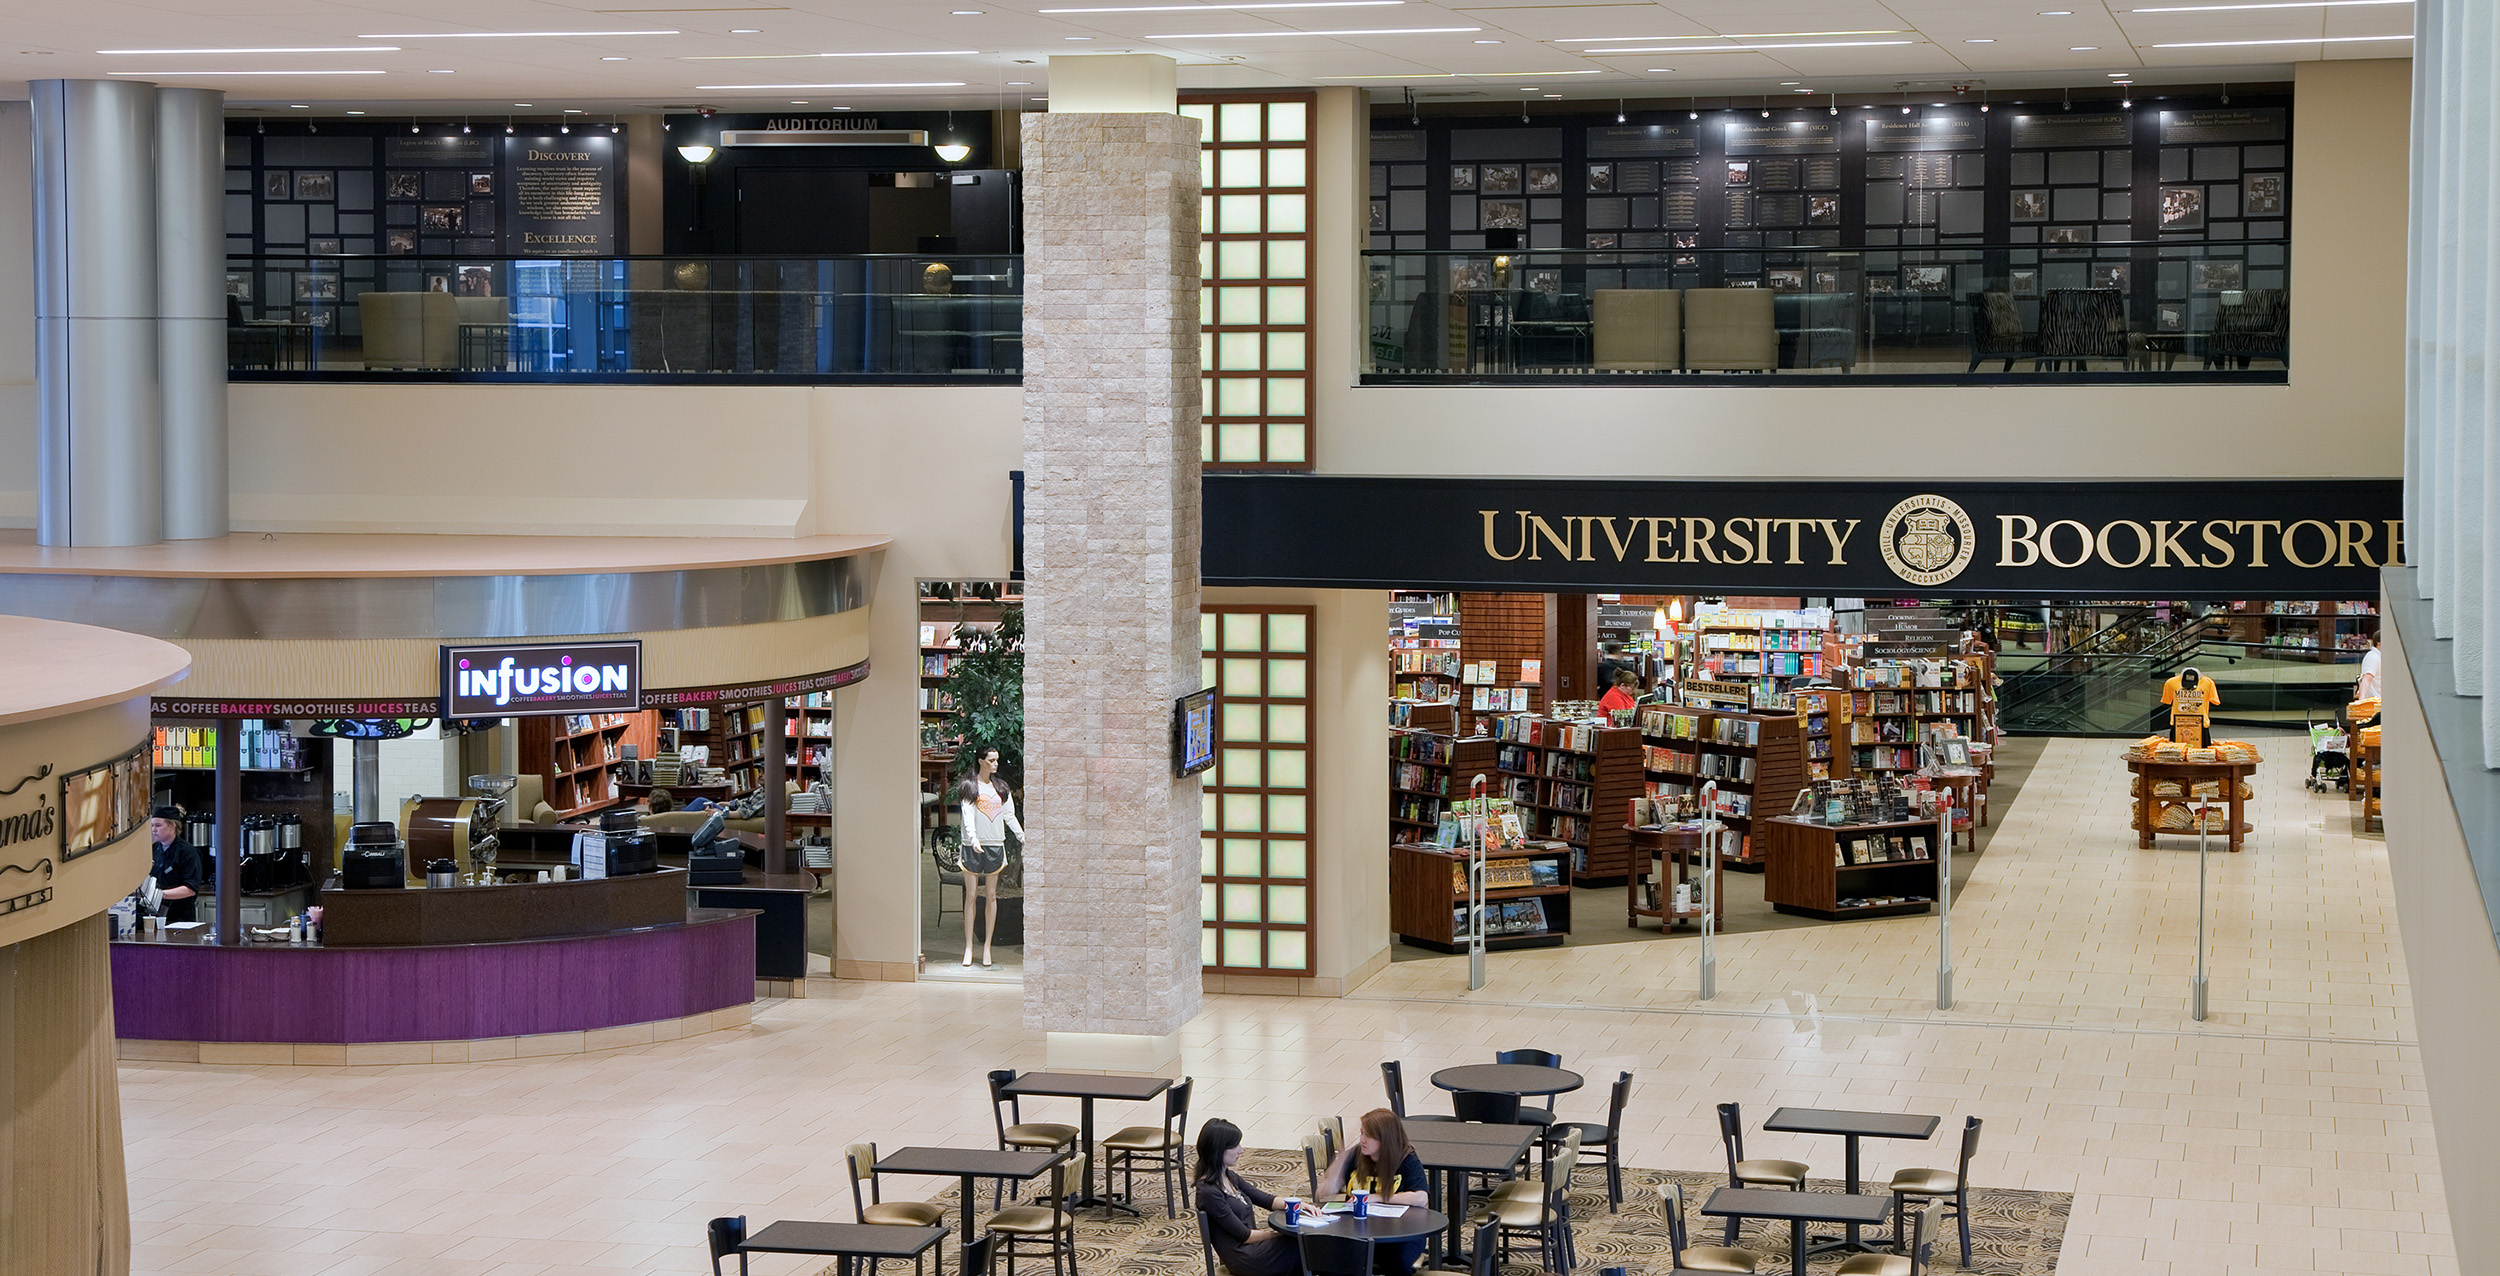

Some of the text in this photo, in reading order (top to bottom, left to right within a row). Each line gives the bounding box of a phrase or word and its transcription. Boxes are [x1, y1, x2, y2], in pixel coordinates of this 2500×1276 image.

[766, 118, 878, 131] AUDITORIUM
[528, 150, 591, 160] DISCOVERY
[524, 232, 598, 244] EXCELLENCE
[1886, 498, 1946, 528] UNIVERSITATIS
[1478, 510, 1861, 565] UNIVERSITY
[1952, 509, 1972, 561] MISSOURIEN
[1995, 515, 2406, 569] BOOKSTORE
[1882, 535, 1894, 561] SIGILL
[1898, 568, 1955, 584] MDCCCXXXIX
[678, 690, 719, 703] BAKERY
[718, 685, 772, 701] SMOOTHIES
[798, 679, 814, 691] TEAS
[1686, 682, 1746, 696] BESTSELLERS
[151, 703, 168, 713] AS
[220, 703, 273, 715] BAKERY
[273, 702, 355, 715] SMOOTHIES
[404, 702, 438, 714] TEAS
